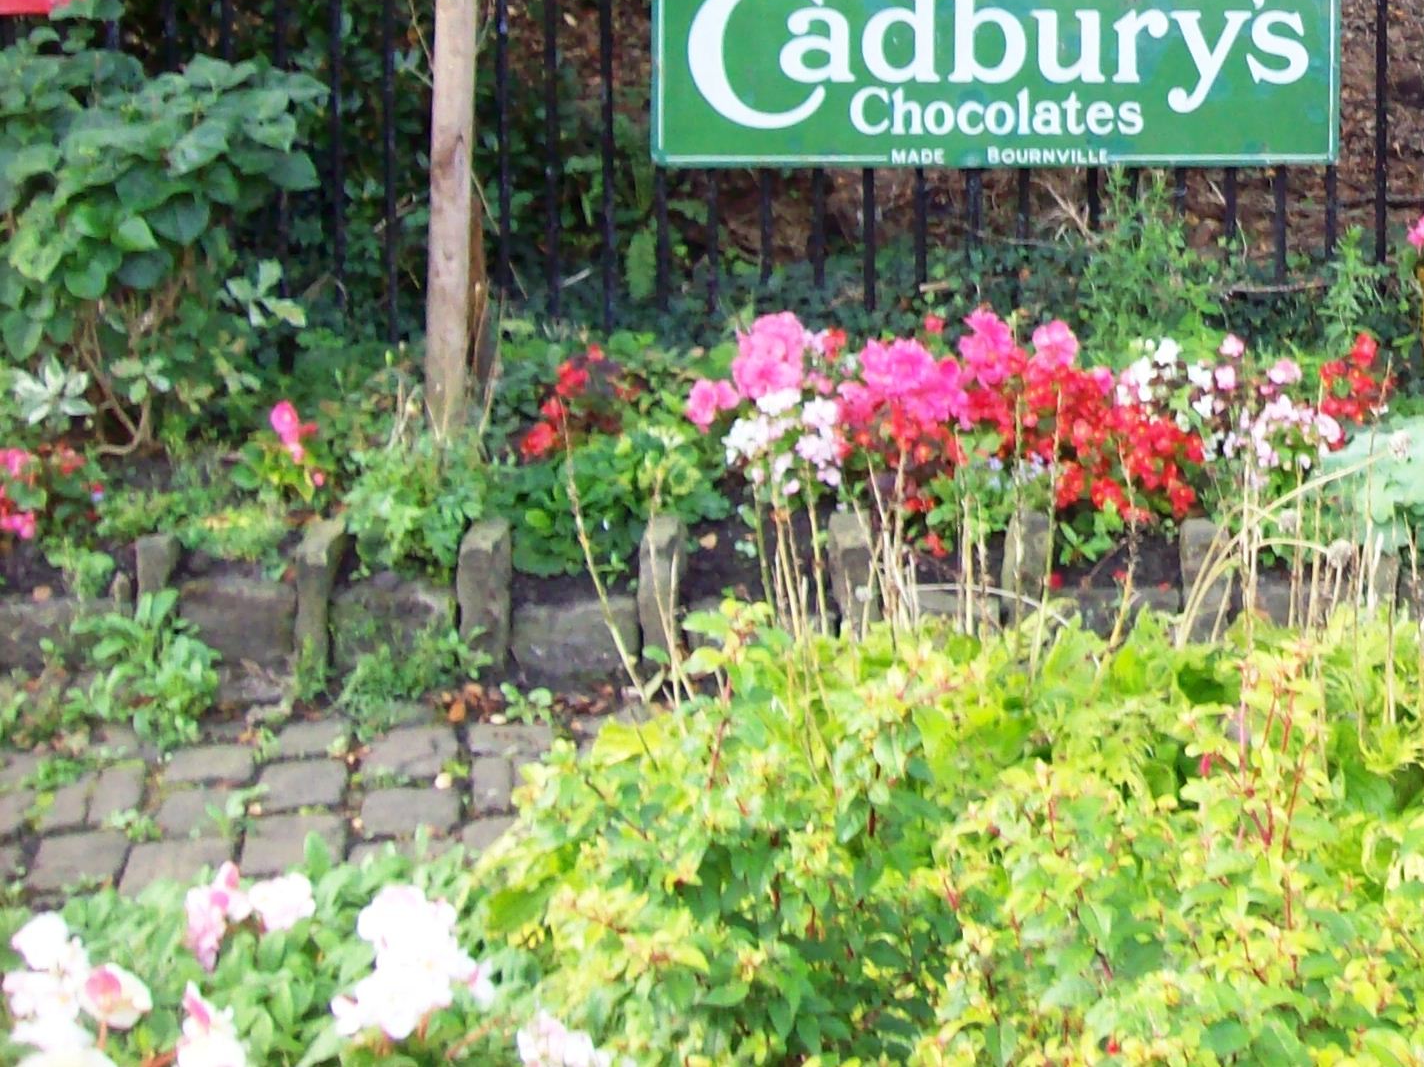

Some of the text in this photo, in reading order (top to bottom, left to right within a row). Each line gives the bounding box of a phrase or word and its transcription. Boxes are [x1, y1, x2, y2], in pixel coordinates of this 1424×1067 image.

[849, 86, 1143, 136] Chocolates
[891, 145, 1108, 165] MADE BOURNVILLE
